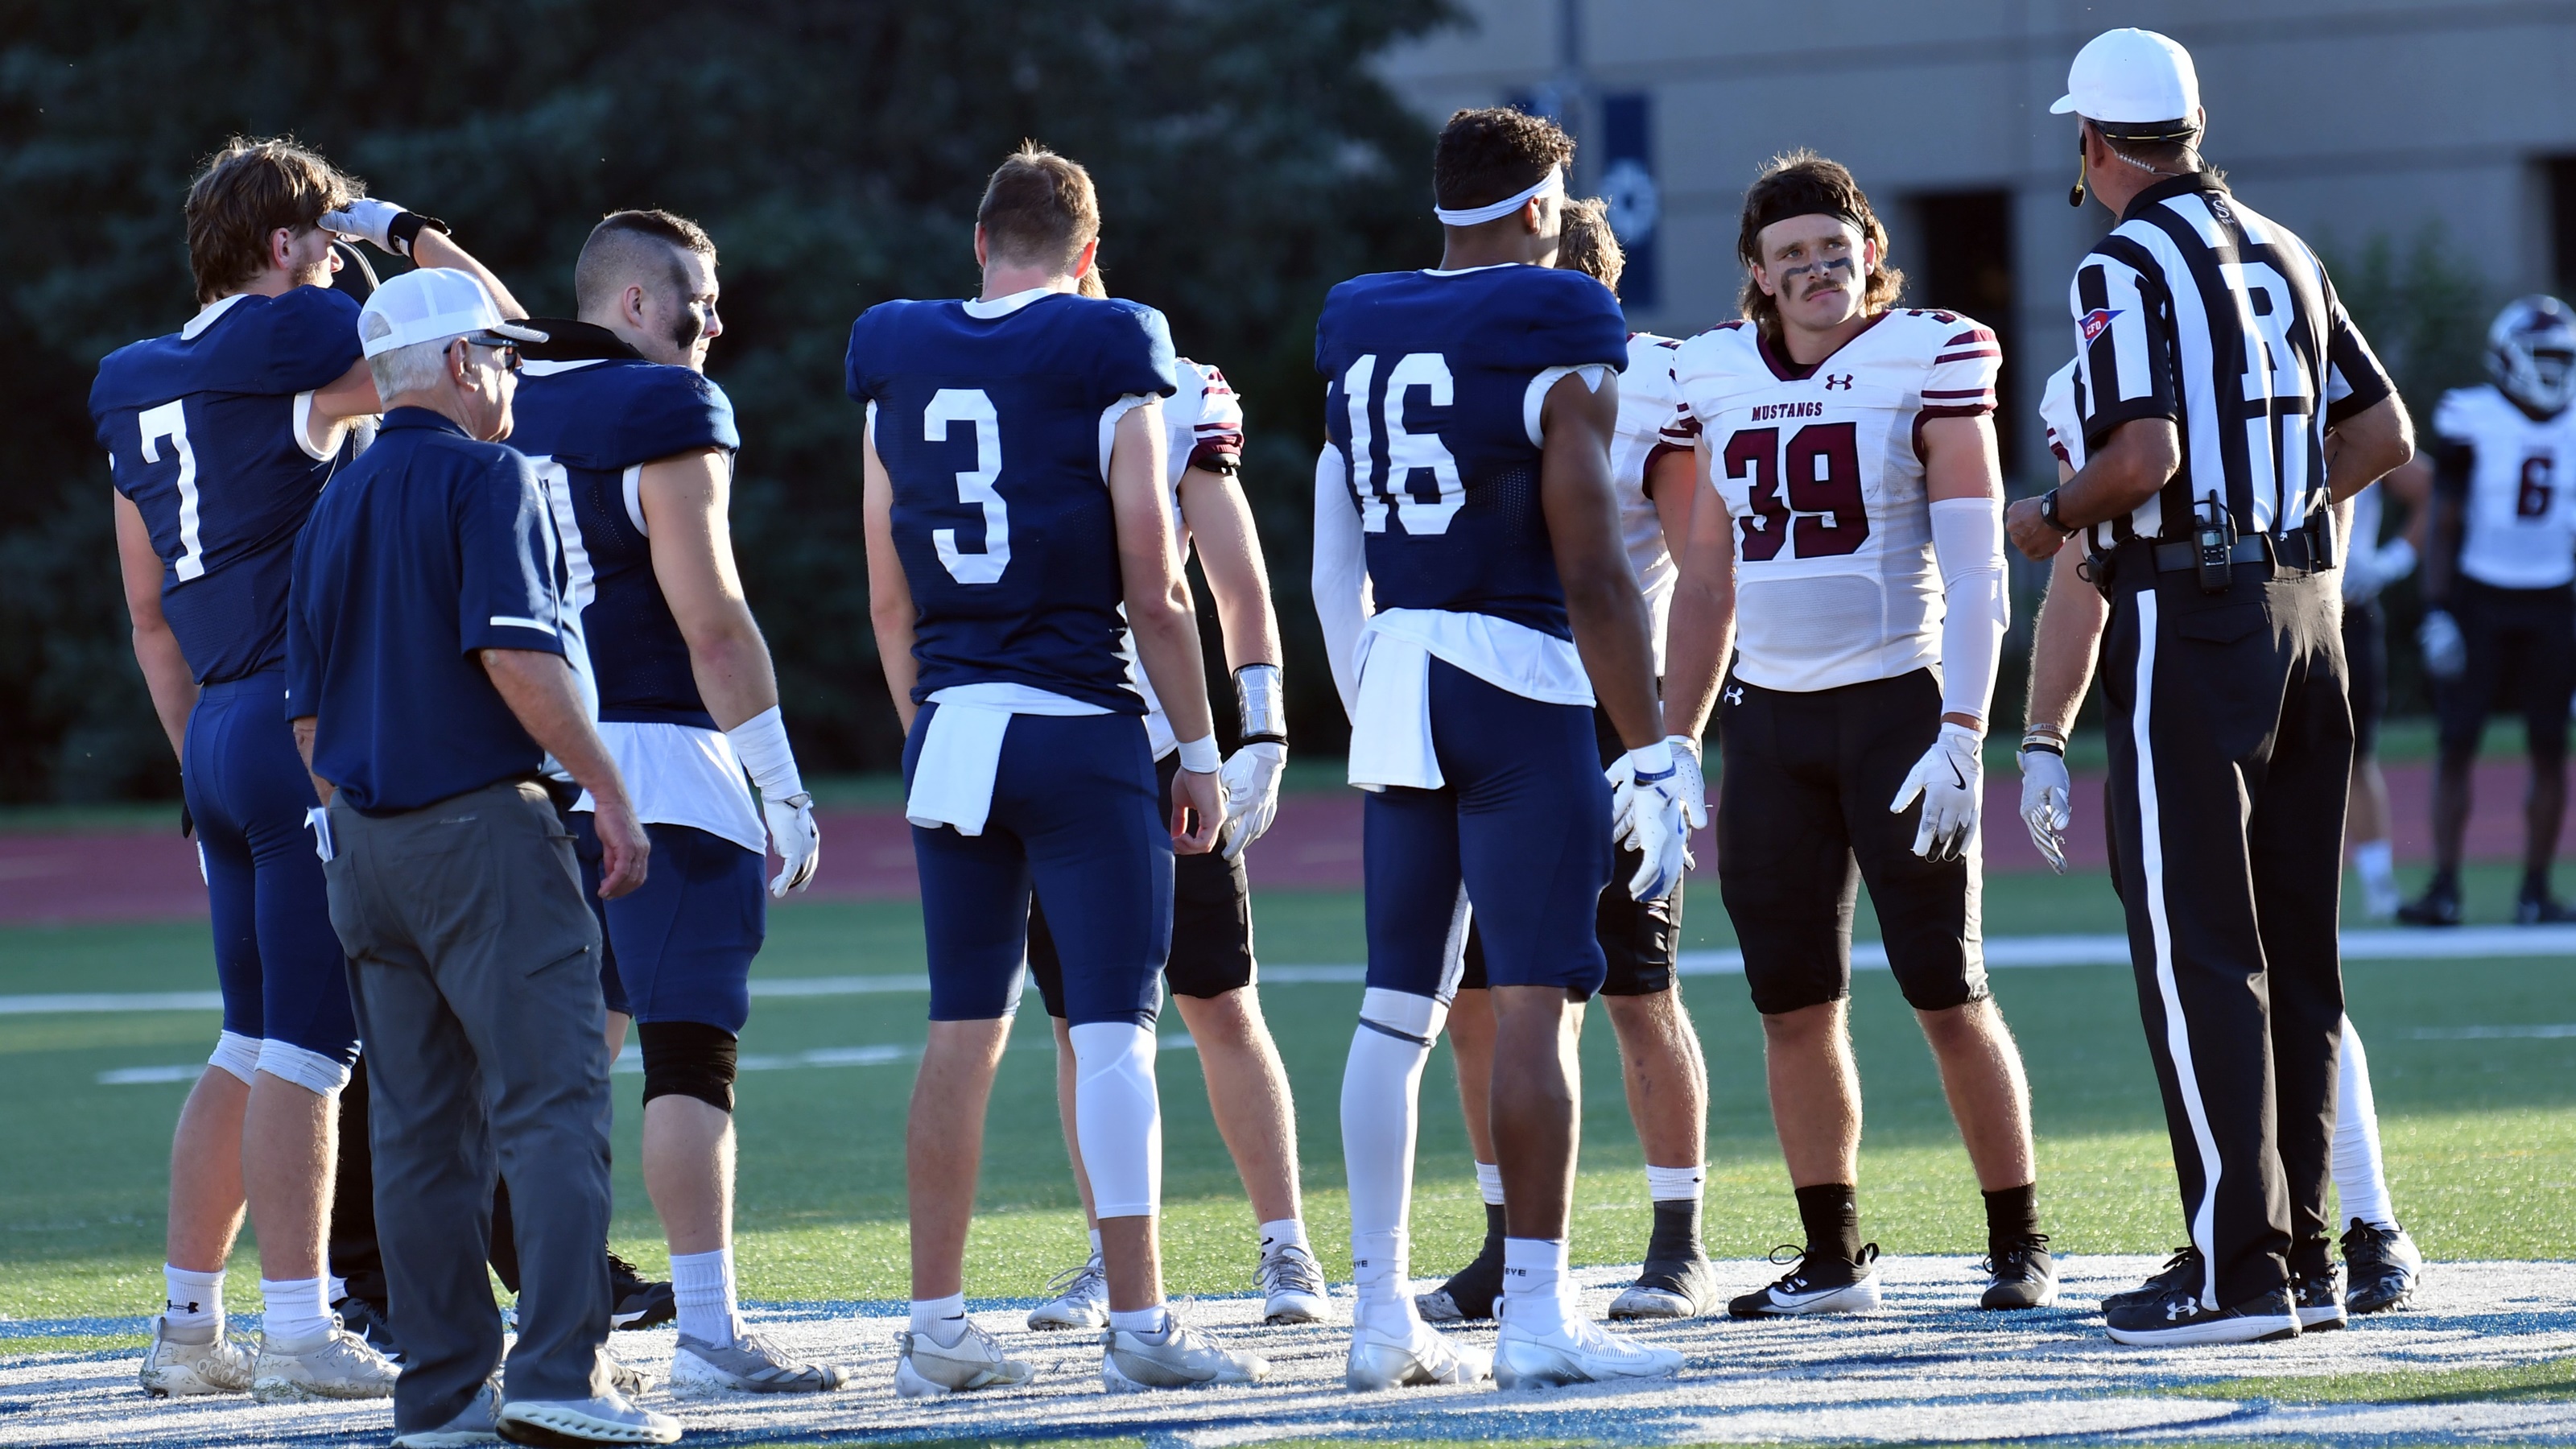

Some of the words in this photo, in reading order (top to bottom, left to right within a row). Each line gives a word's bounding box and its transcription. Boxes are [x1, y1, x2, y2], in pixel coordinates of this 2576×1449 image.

[2087, 320, 2102, 336] CFO
[2219, 262, 2308, 402] R
[1344, 353, 1467, 535] 16
[1751, 402, 1823, 422] MUSTANGS
[138, 399, 205, 583] 7
[923, 389, 1011, 584] 3
[1724, 422, 1870, 562] 39
[2517, 456, 2554, 518] 6
